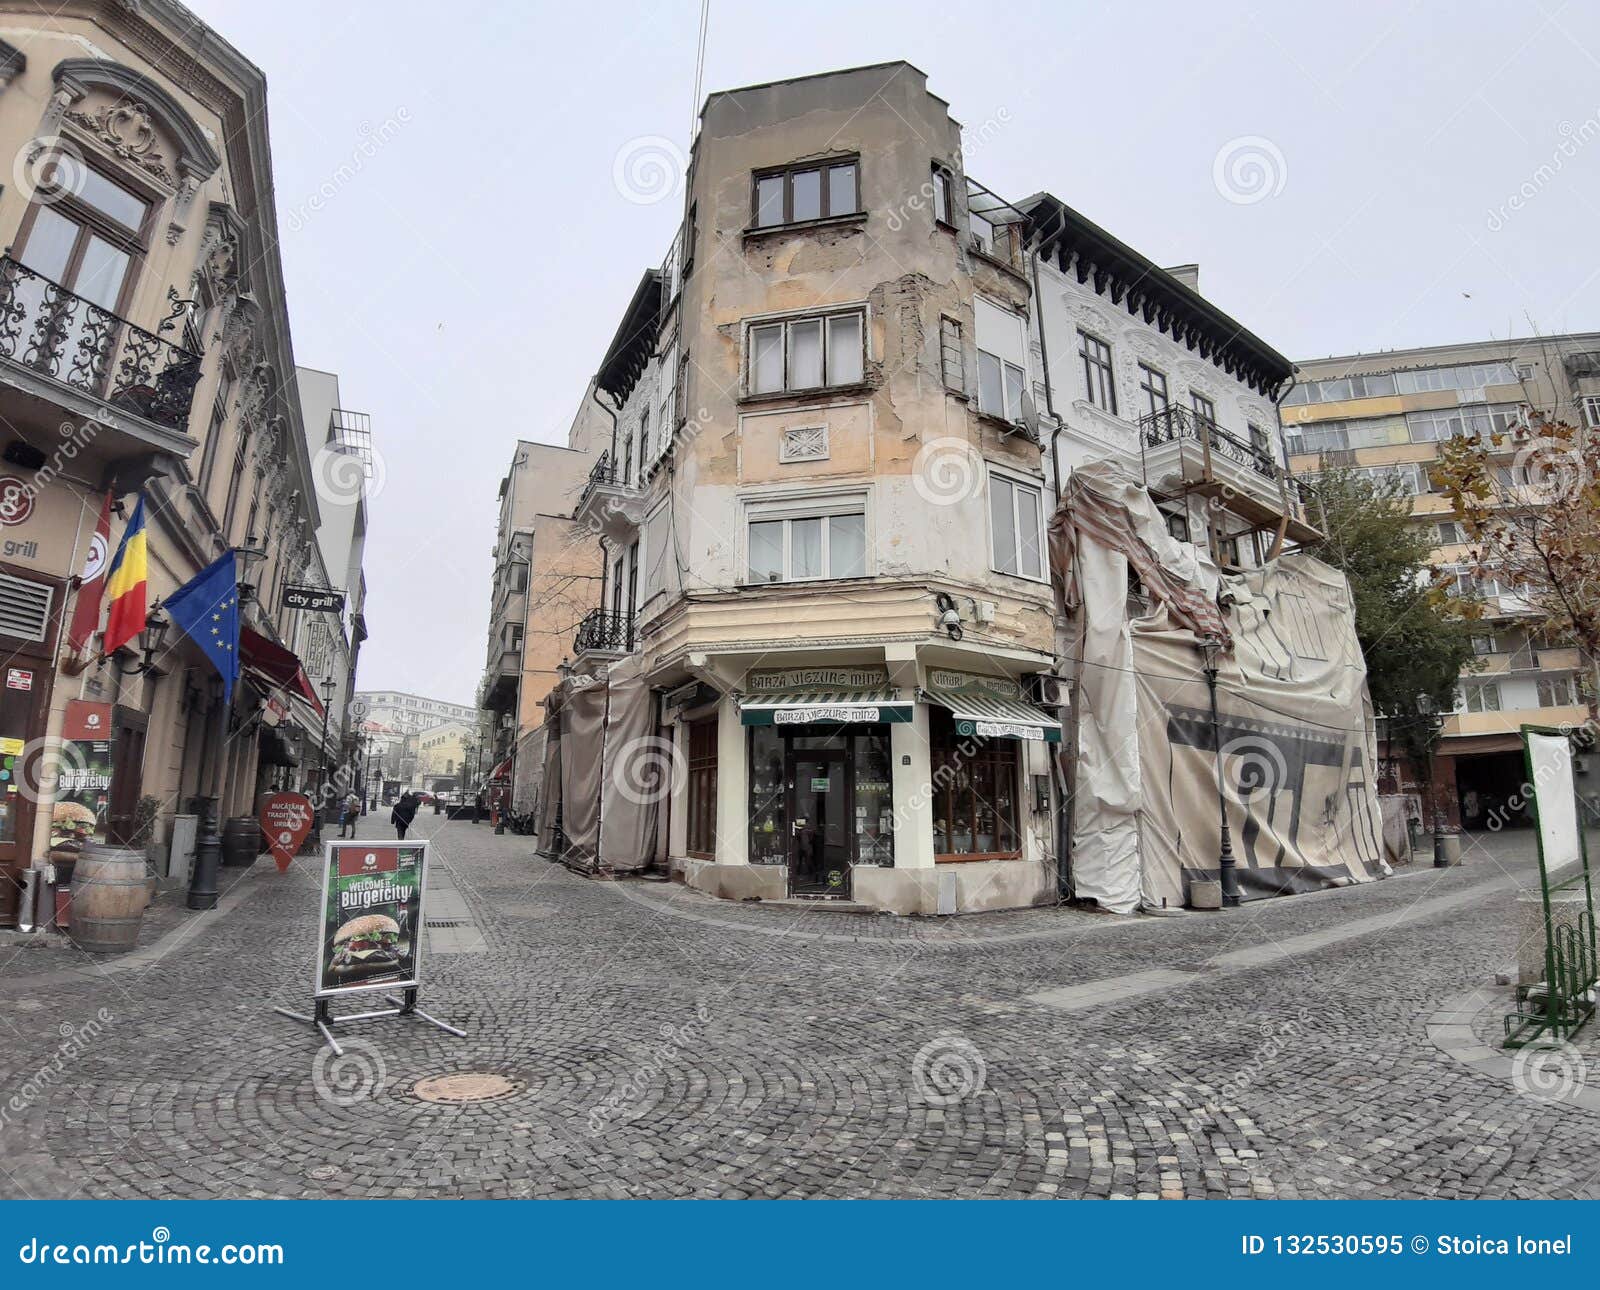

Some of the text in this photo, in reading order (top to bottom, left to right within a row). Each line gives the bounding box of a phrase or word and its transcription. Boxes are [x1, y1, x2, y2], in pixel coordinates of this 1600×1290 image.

[3, 540, 38, 558] grill
[288, 594, 333, 608] city grill
[349, 879, 384, 892] WELCOME
[341, 884, 413, 909] Burgercity!
